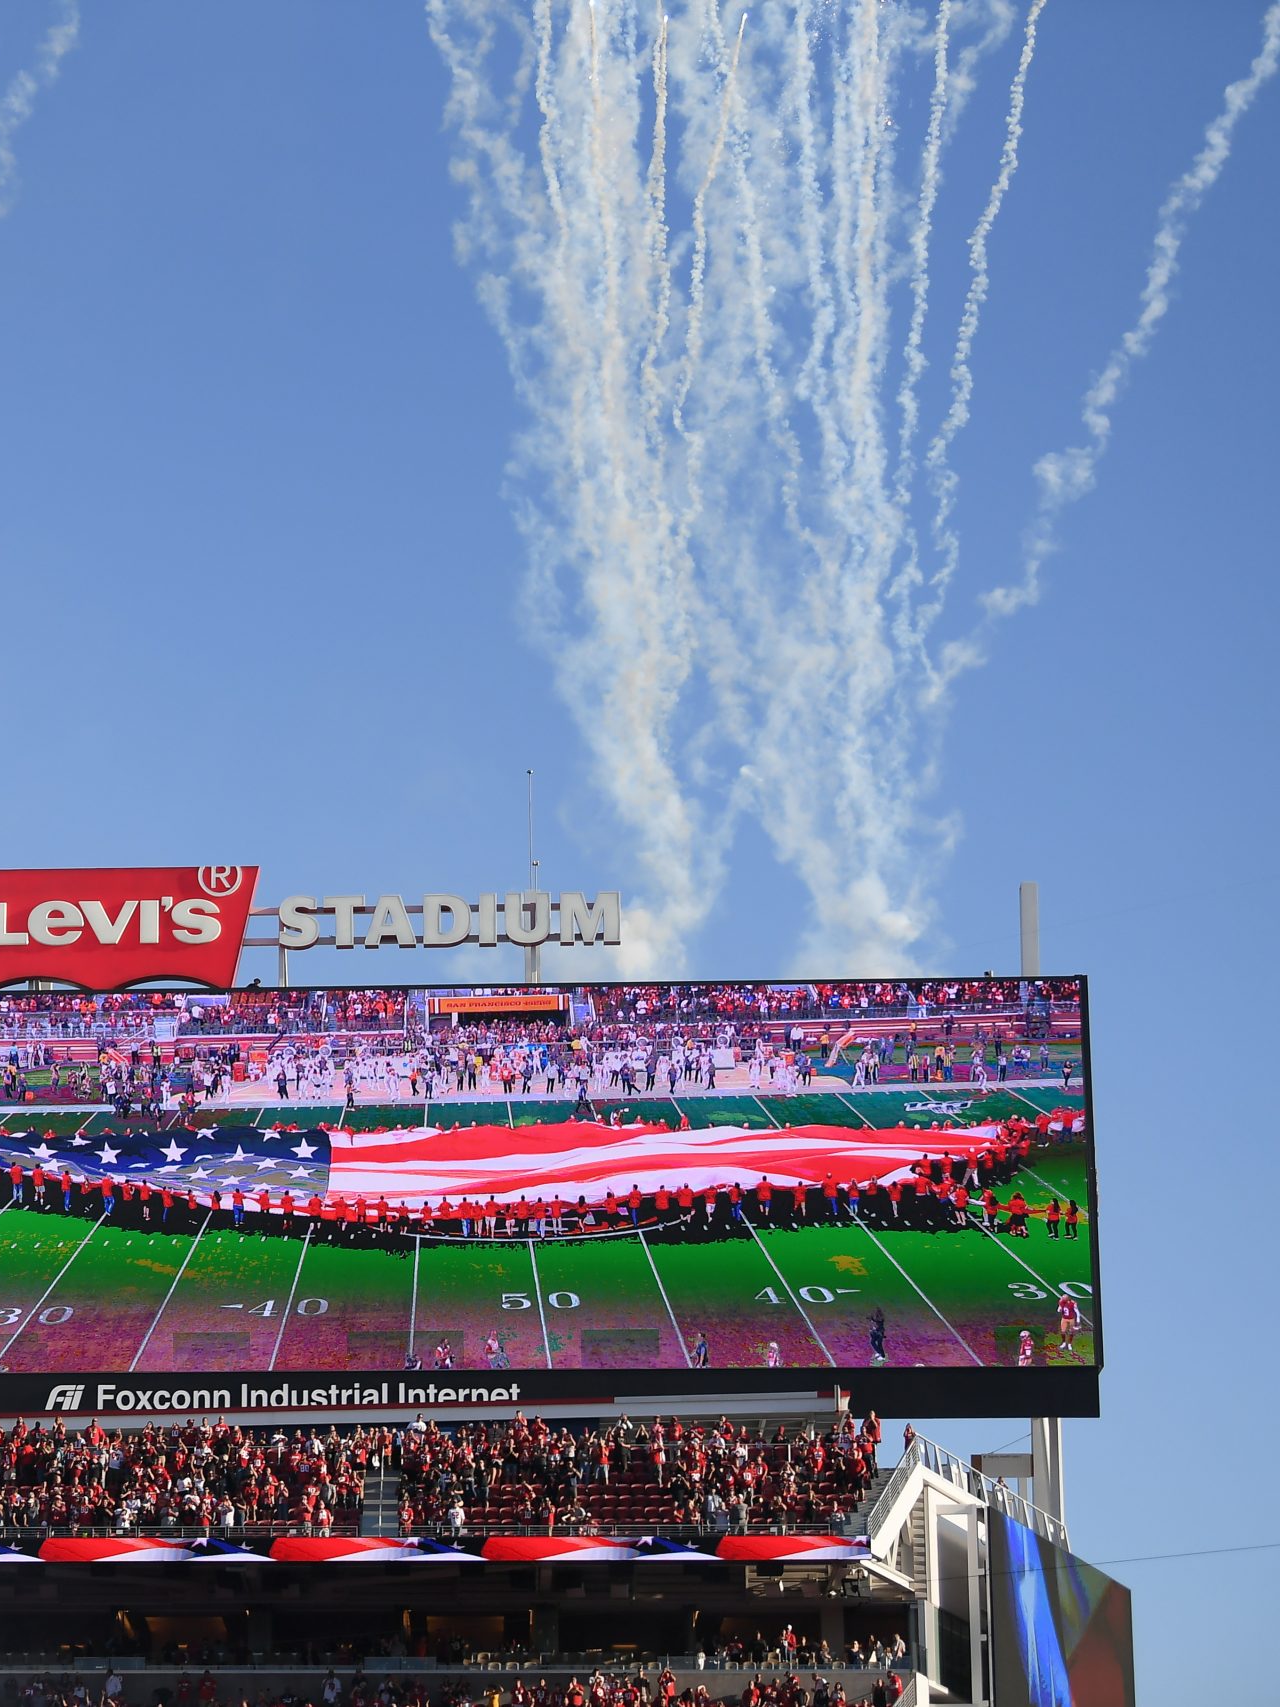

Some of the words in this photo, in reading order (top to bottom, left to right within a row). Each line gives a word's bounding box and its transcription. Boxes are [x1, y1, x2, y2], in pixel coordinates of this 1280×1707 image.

[278, 890, 621, 950] STADIUM
[97, 1384, 231, 1410] Foxconn
[241, 1382, 388, 1408] Industrial
[398, 1382, 520, 1404] Internet
